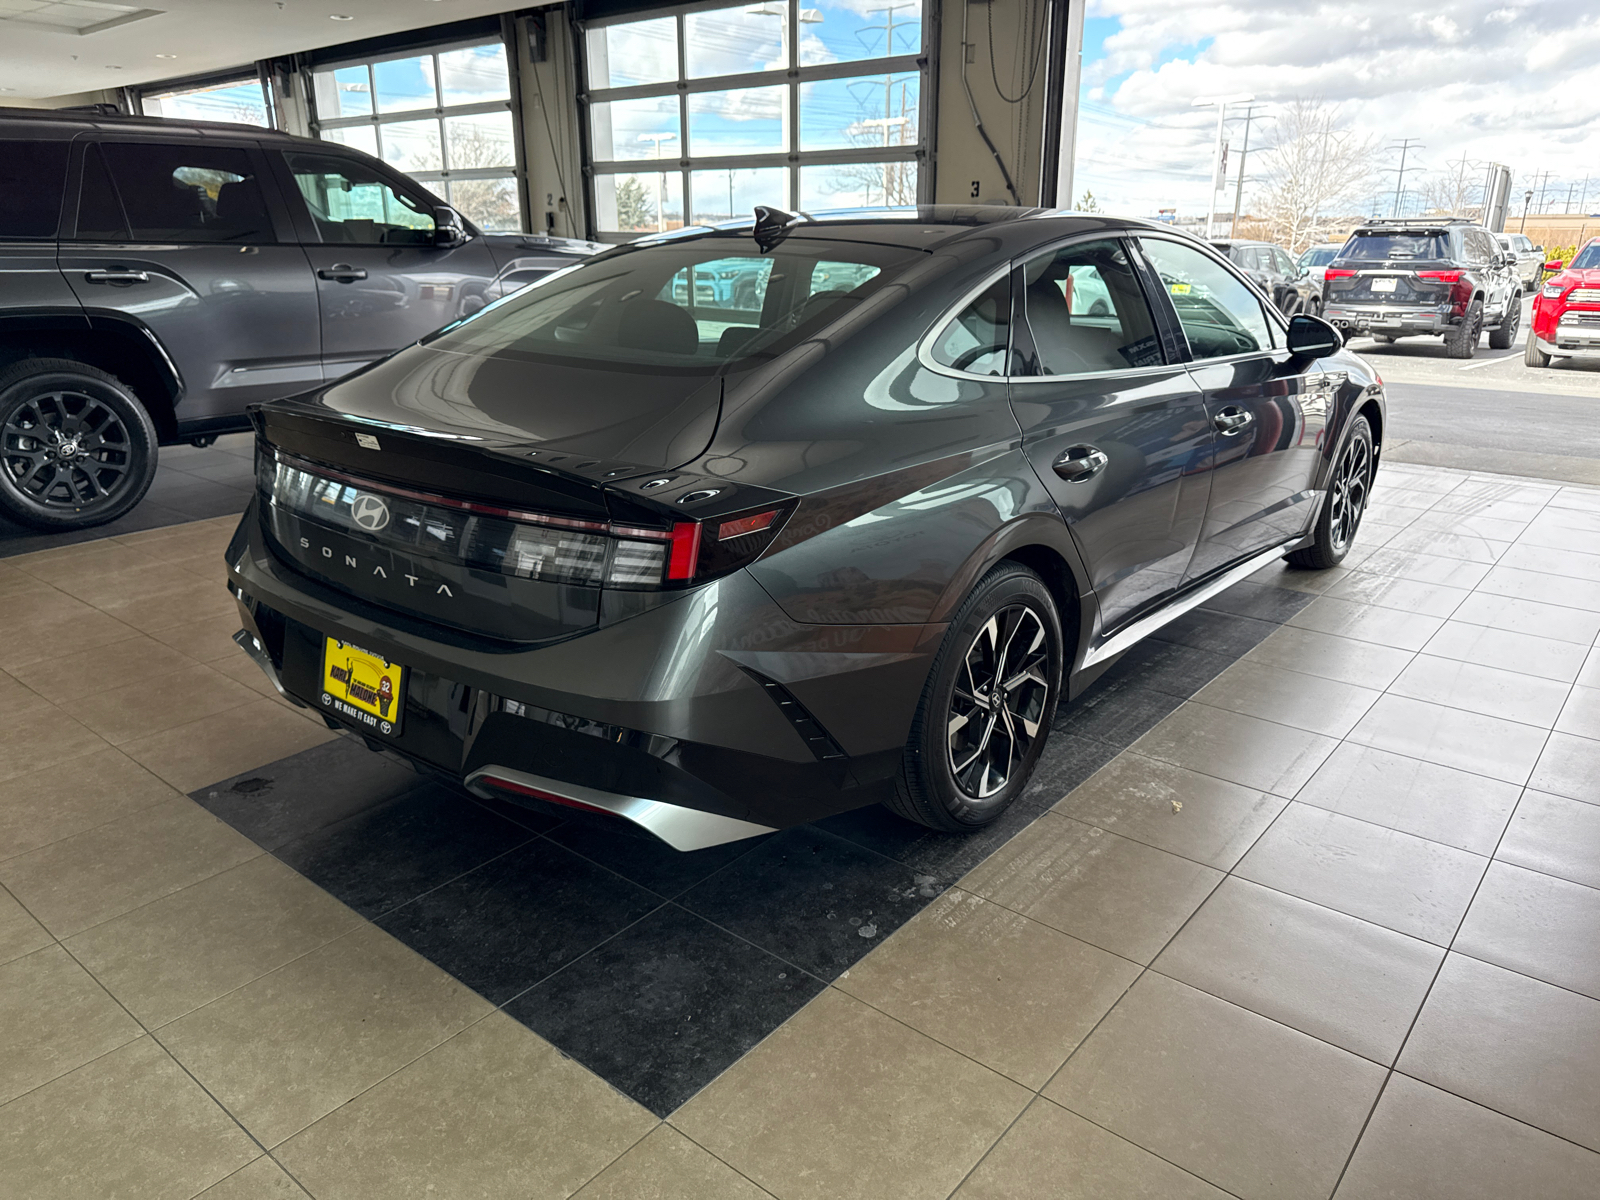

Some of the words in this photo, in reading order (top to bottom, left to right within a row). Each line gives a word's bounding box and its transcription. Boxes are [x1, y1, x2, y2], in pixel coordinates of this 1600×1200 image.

[971, 181, 980, 197] 3
[547, 193, 553, 206] 2
[300, 537, 453, 598] SONATA
[330, 664, 347, 684] KARL
[350, 683, 377, 706] MALONE
[381, 681, 390, 693] 32
[334, 700, 342, 711] WE
[343, 702, 356, 718] MAKE
[357, 711, 363, 721] IT
[364, 714, 377, 727] EASY
